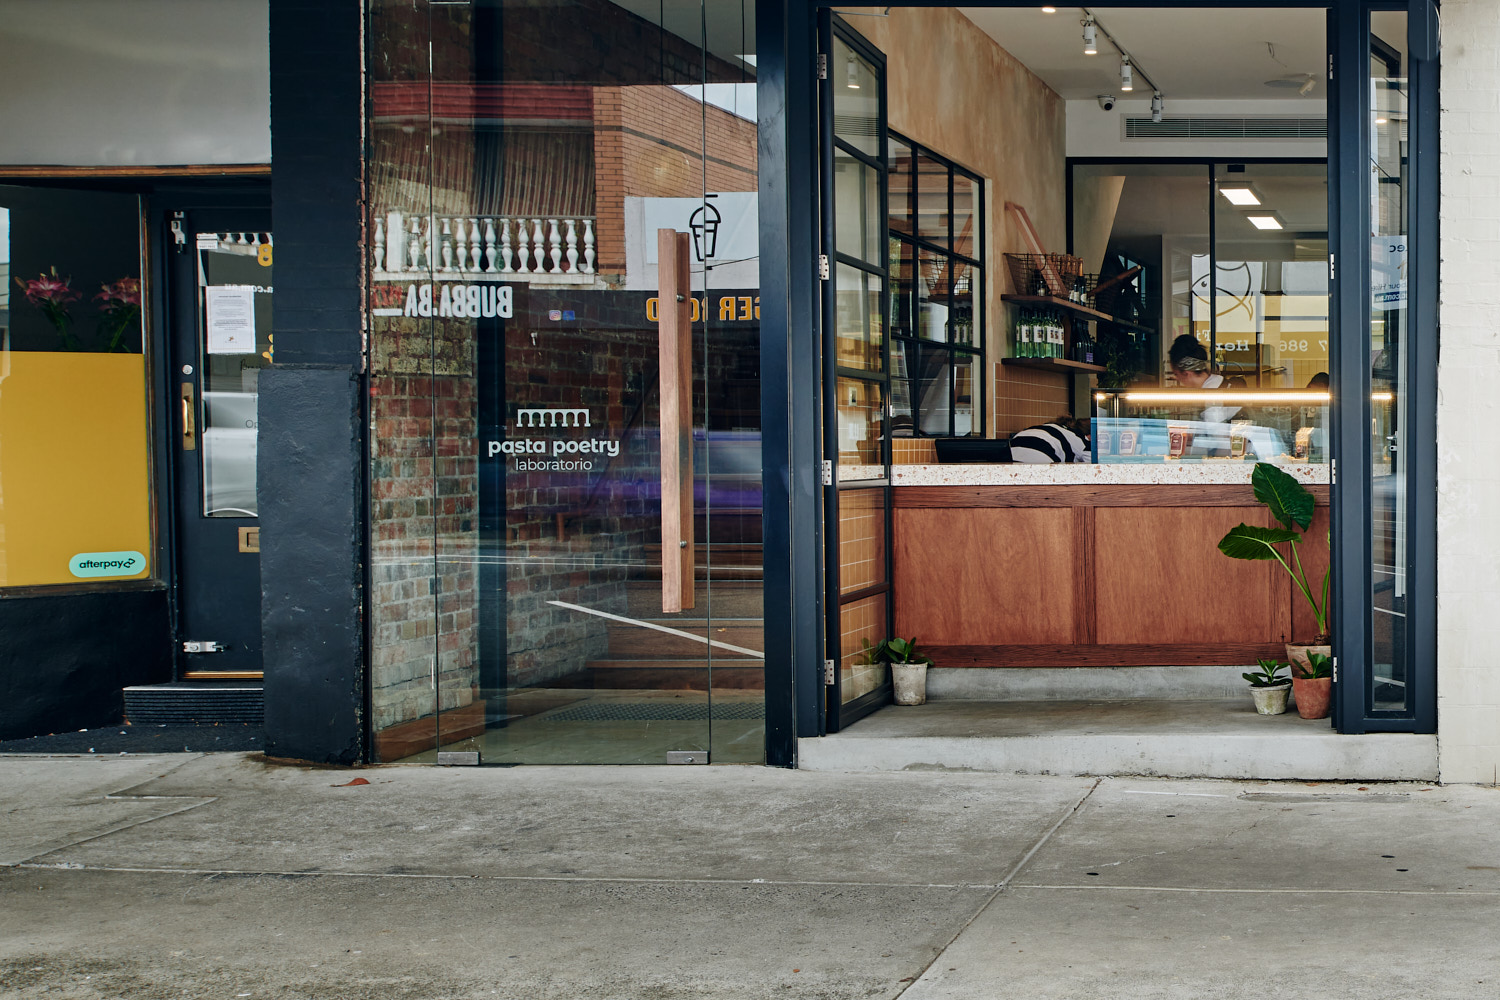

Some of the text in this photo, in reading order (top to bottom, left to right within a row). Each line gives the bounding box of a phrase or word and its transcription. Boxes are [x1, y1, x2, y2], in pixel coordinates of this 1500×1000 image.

[488, 438, 620, 457] pasta poetry
[515, 457, 593, 471] laboratorio
[79, 559, 124, 570] afterpay
